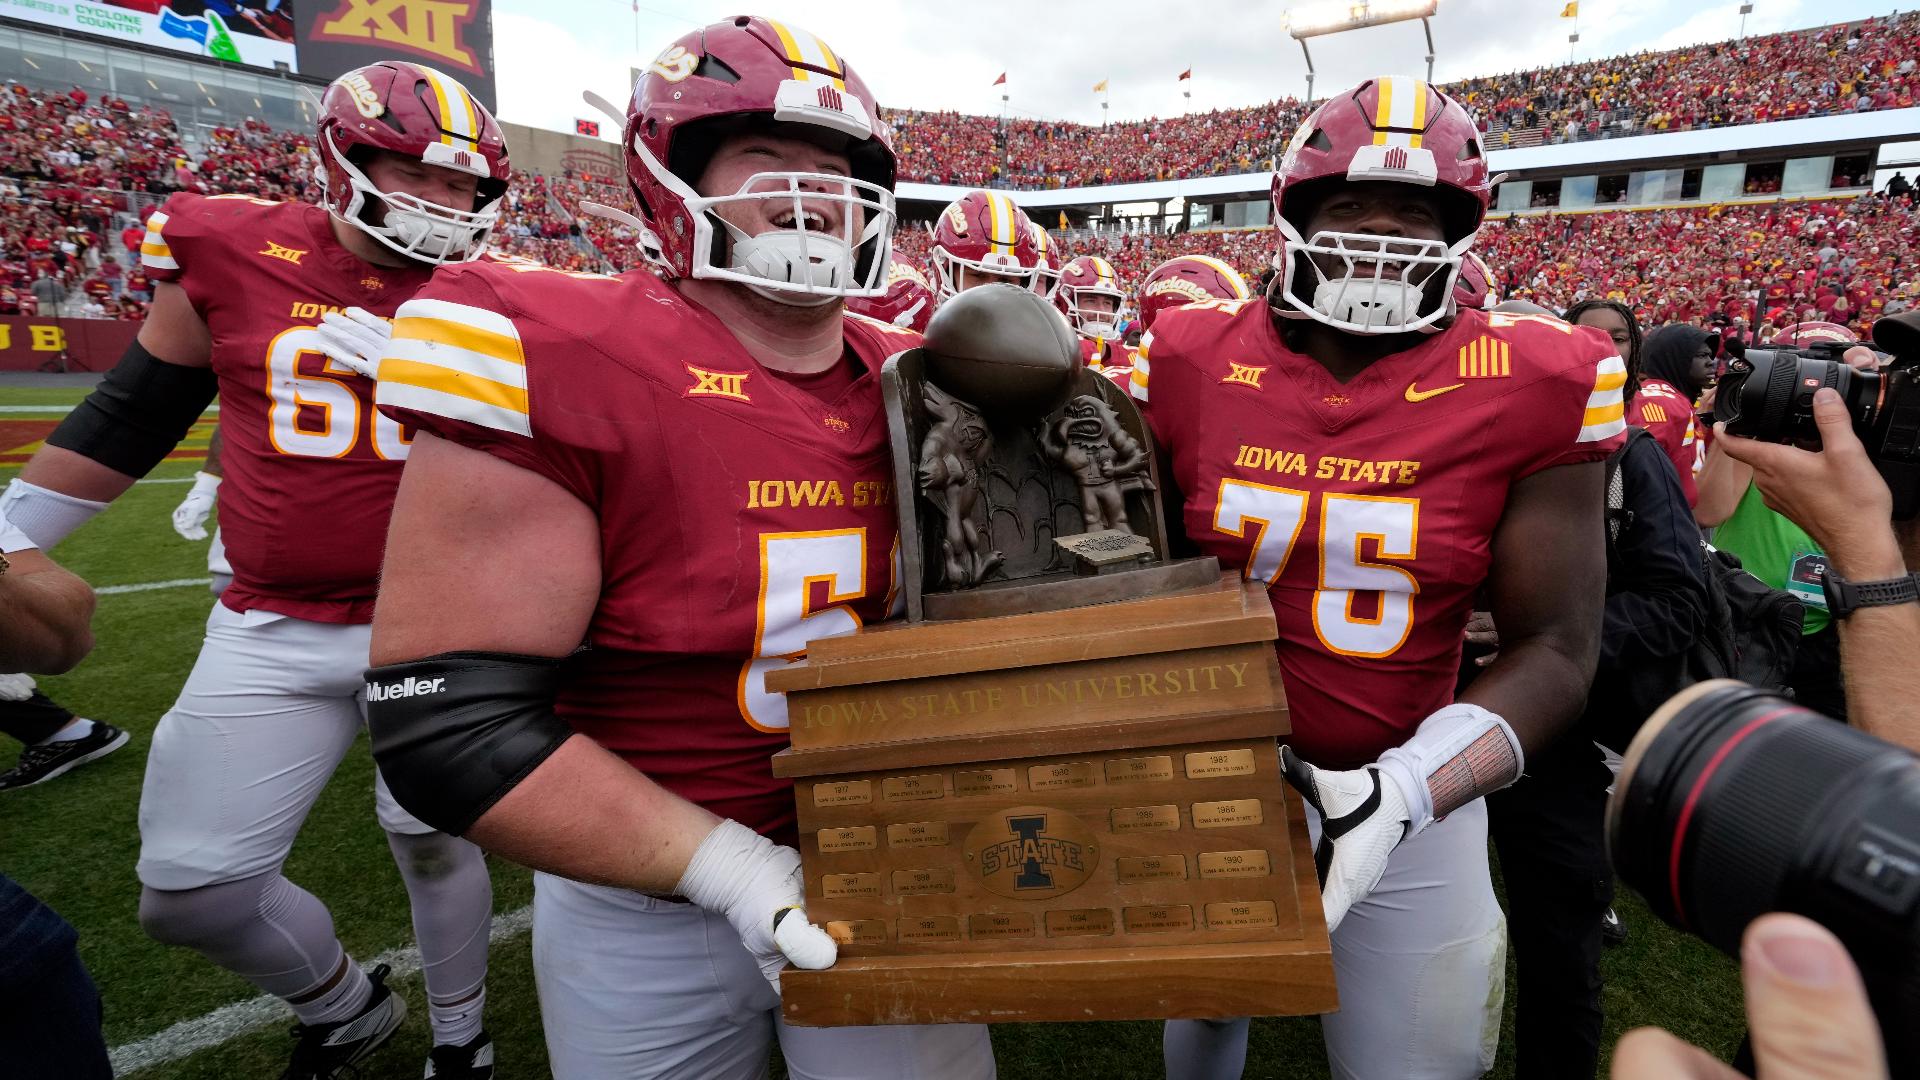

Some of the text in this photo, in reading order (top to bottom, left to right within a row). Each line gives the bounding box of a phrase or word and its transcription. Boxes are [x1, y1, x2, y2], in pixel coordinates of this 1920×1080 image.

[75, 4, 142, 25] CYCLONE
[77, 15, 143, 34] COUNTRY
[577, 120, 599, 137] 25
[258, 240, 307, 264] XII
[686, 364, 752, 401] XII
[1221, 361, 1268, 388] XII
[1234, 445, 1421, 485] IOWA STATE
[746, 480, 846, 509] IOWA
[1213, 477, 1421, 659] 75
[366, 676, 445, 702] Mueller
[803, 662, 1250, 730] IOWA STATE UNIVERSITY
[1209, 755, 1229, 765] 1982
[981, 838, 1084, 877] STATE
[1223, 856, 1243, 864] 1990
[1231, 908, 1250, 916] 1996
